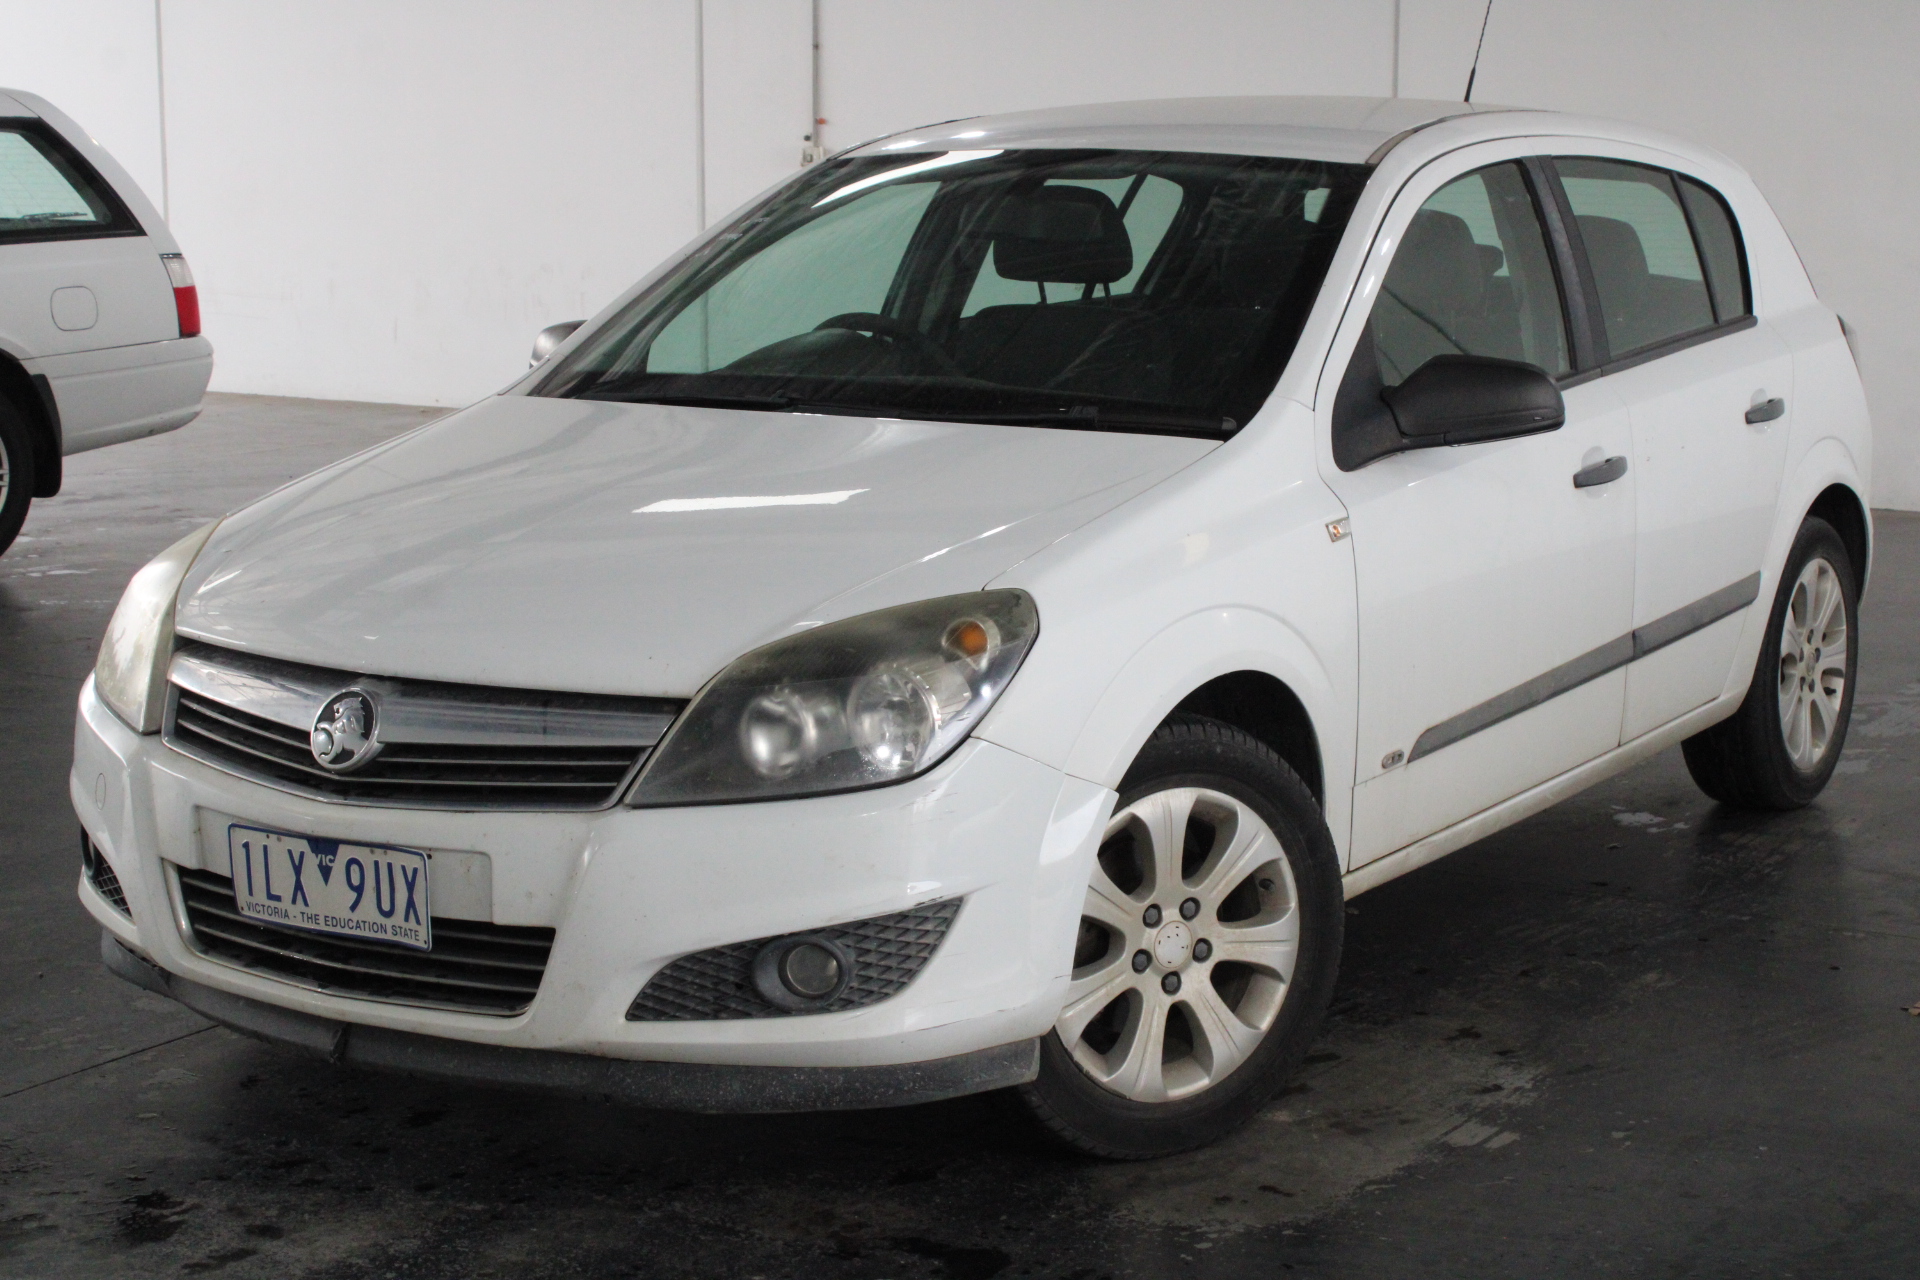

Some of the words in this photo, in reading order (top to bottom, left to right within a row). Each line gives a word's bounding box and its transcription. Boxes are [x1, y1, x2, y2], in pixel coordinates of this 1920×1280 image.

[315, 853, 335, 867] VIC
[241, 840, 309, 907] 1LX
[345, 857, 421, 925] 9UX
[245, 901, 290, 920] VICTORIA
[300, 911, 320, 925] THE
[324, 915, 388, 935] EDUCATION
[391, 925, 420, 942] STATE
